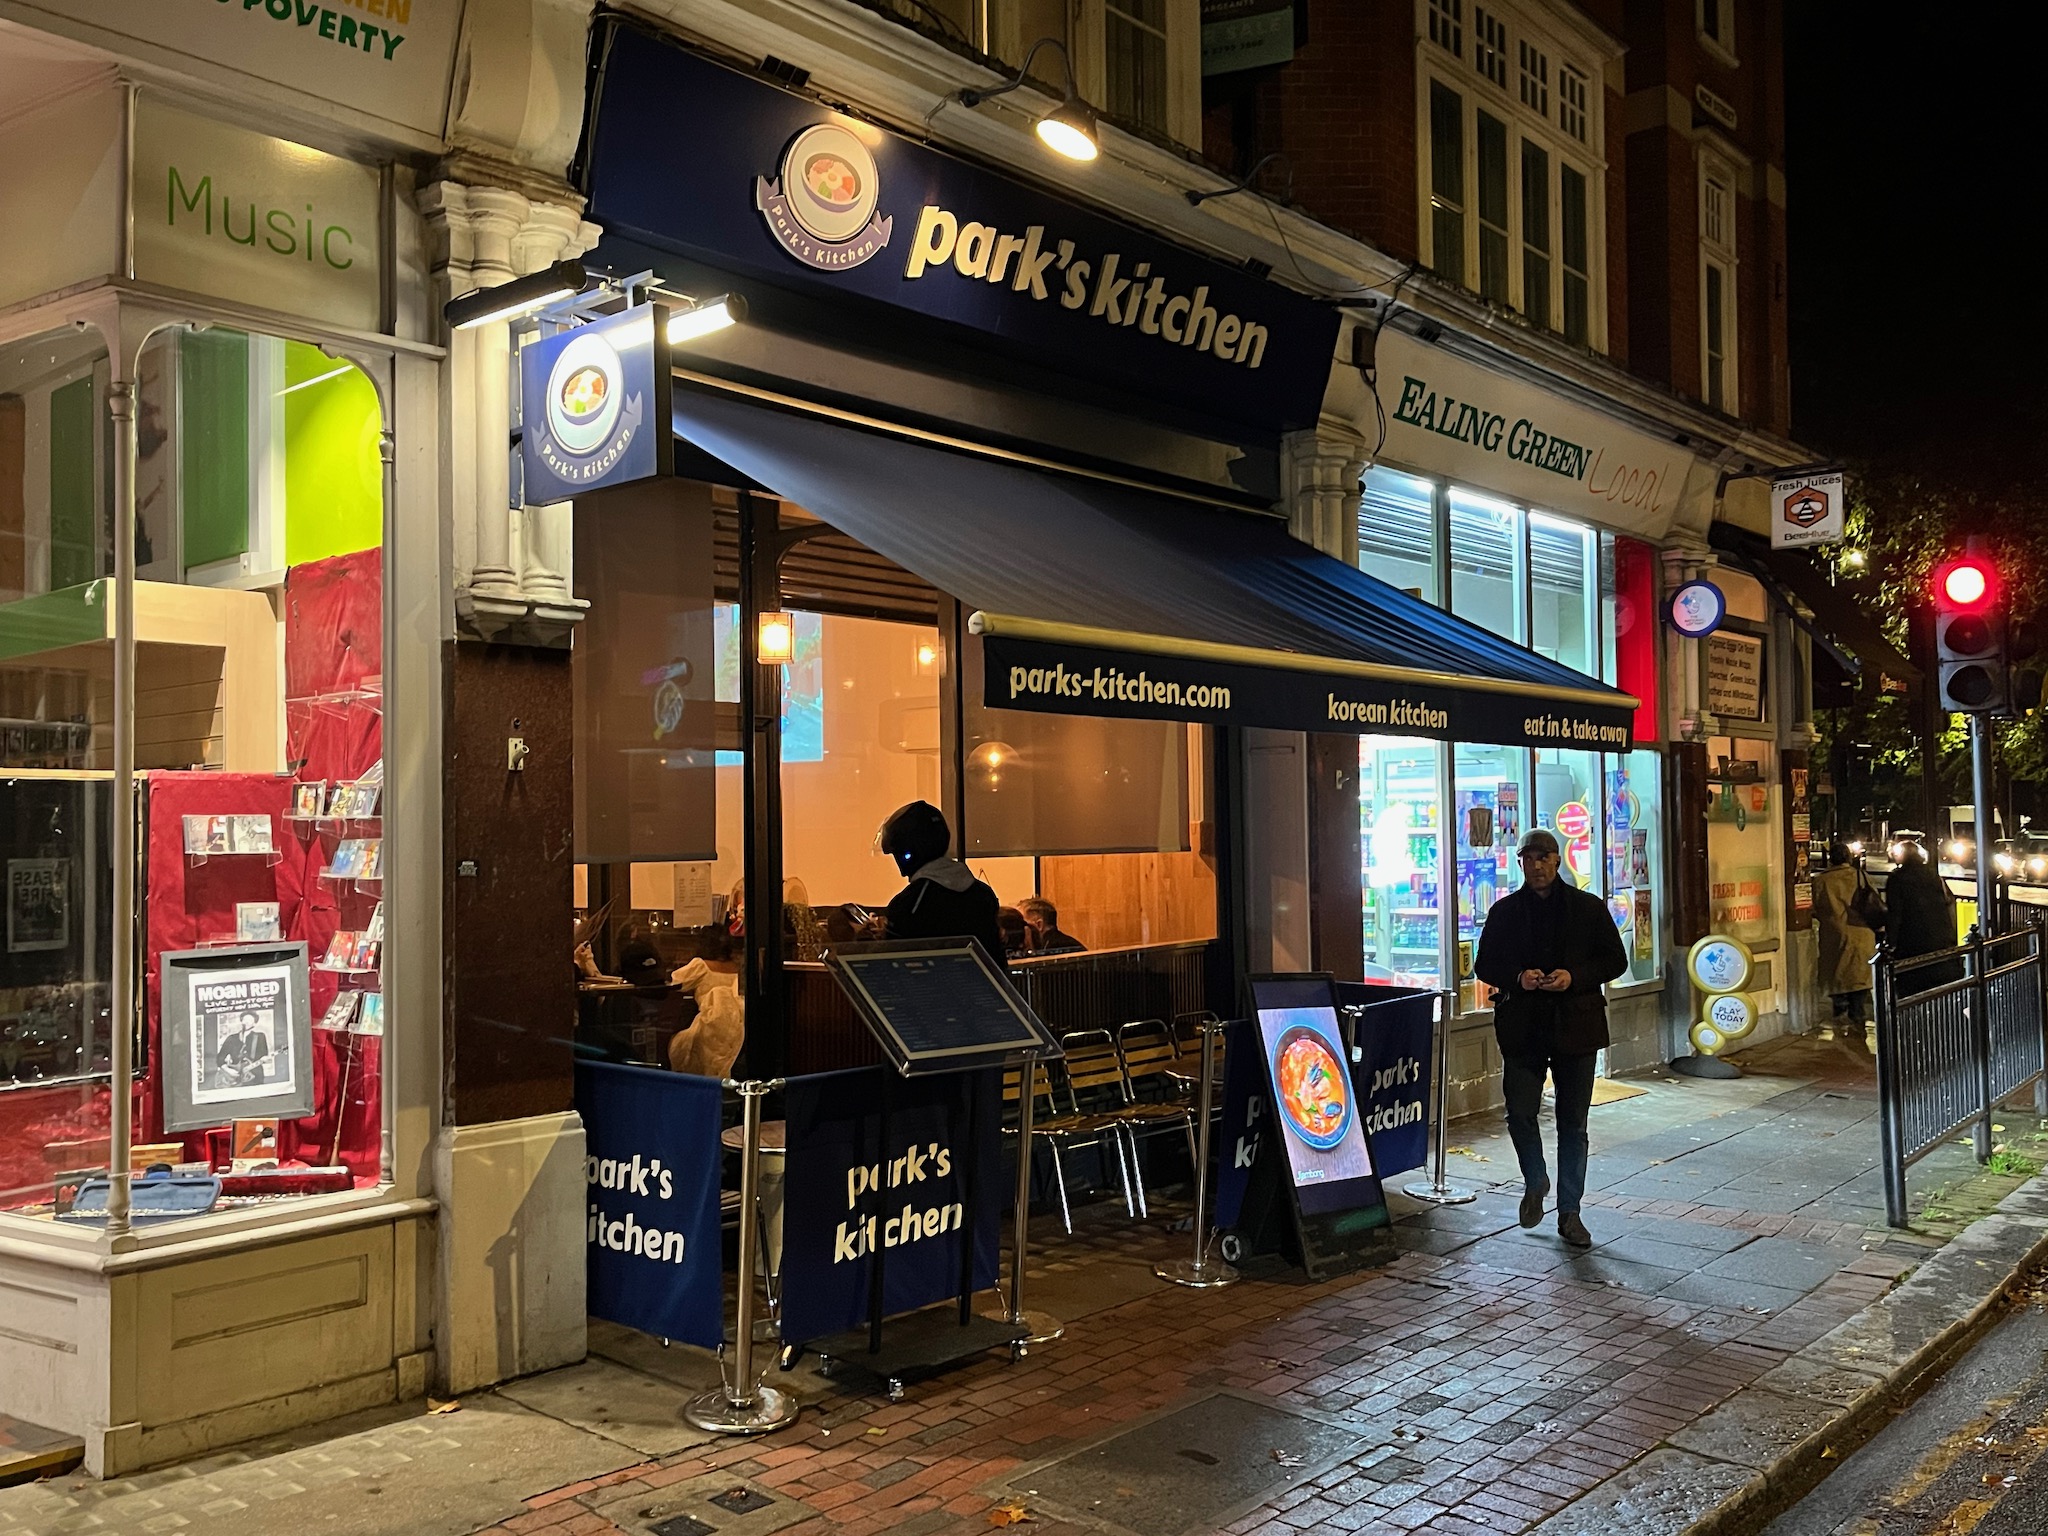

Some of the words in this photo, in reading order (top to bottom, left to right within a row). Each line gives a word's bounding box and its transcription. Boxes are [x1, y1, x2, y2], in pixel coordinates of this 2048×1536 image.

[167, 166, 354, 270] Music
[771, 204, 811, 257] Park's
[815, 240, 874, 264] Kitchen
[903, 204, 1091, 310] park's
[1090, 253, 1268, 369] kitchen
[543, 443, 579, 479] Park's
[583, 429, 631, 478] Kitchen
[1771, 480, 1803, 493] Fresh
[1805, 476, 1841, 487] Juices
[1009, 662, 1231, 710] parks-kitchen.com
[1327, 692, 1388, 724] korean
[1389, 698, 1448, 729] kitchen
[1523, 715, 1545, 738] eat
[1546, 713, 1560, 738] in
[1560, 717, 1571, 738] &
[1572, 717, 1599, 742] take
[1599, 723, 1628, 748] away
[249, 981, 280, 997] RED
[1718, 1006, 1741, 1015] PLAY
[1714, 1012, 1745, 1023] TODAY
[587, 1203, 685, 1264] itchen
[833, 1202, 963, 1265] kitchen
